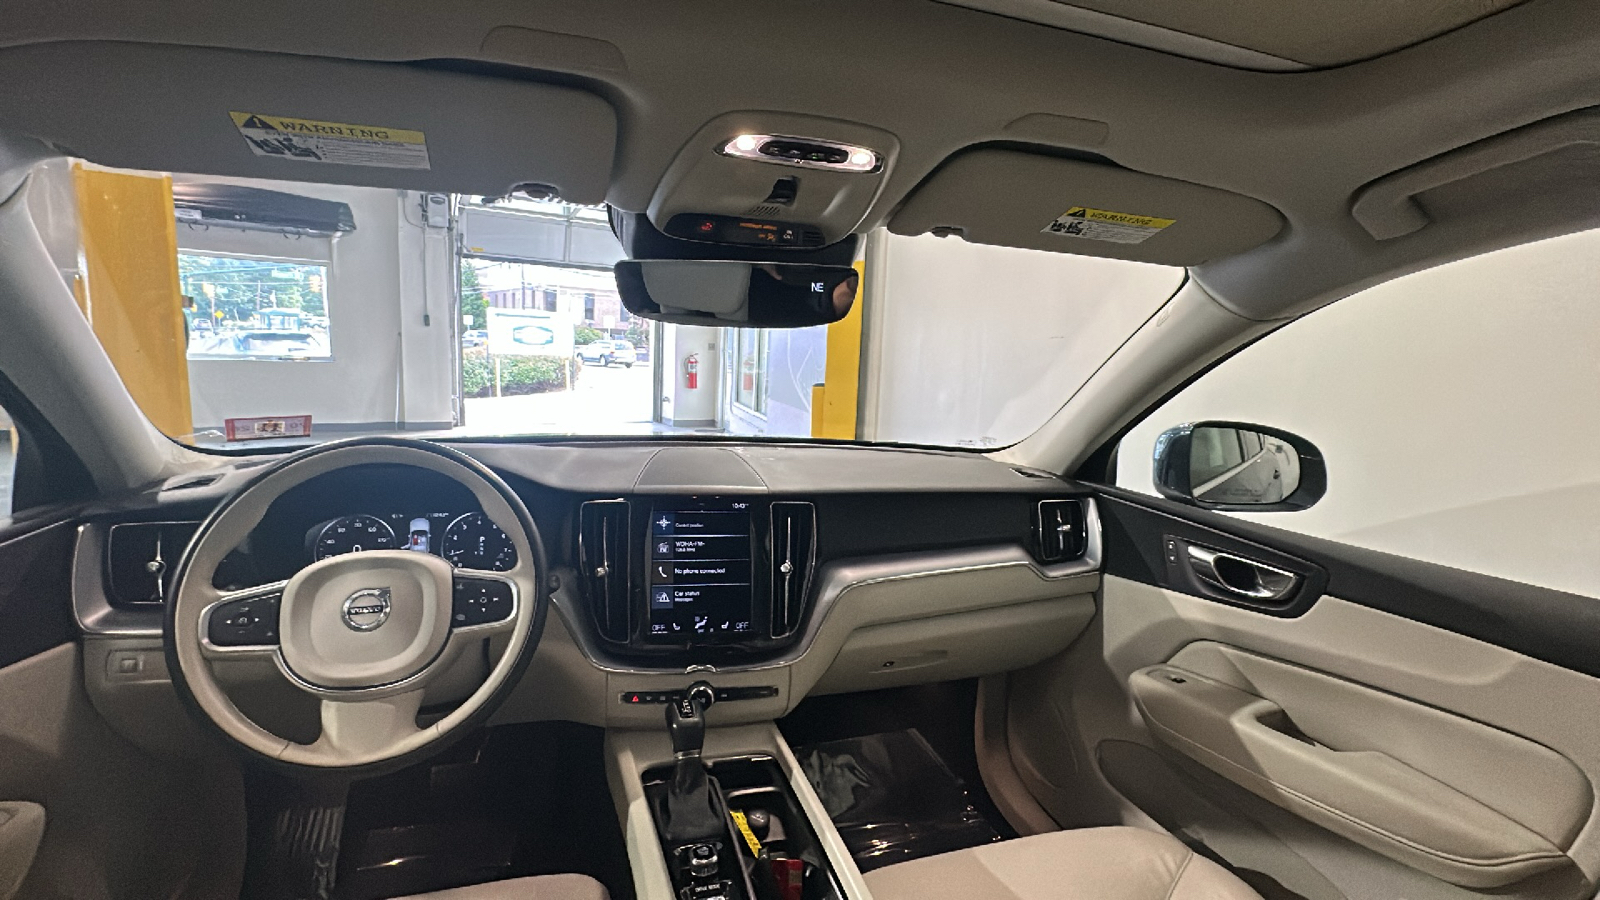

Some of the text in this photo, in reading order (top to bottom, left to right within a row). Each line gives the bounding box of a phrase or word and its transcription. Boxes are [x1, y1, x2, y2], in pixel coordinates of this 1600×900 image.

[279, 121, 390, 139] WARNING
[1090, 212, 1153, 226] WARNING
[811, 282, 824, 293] NE
